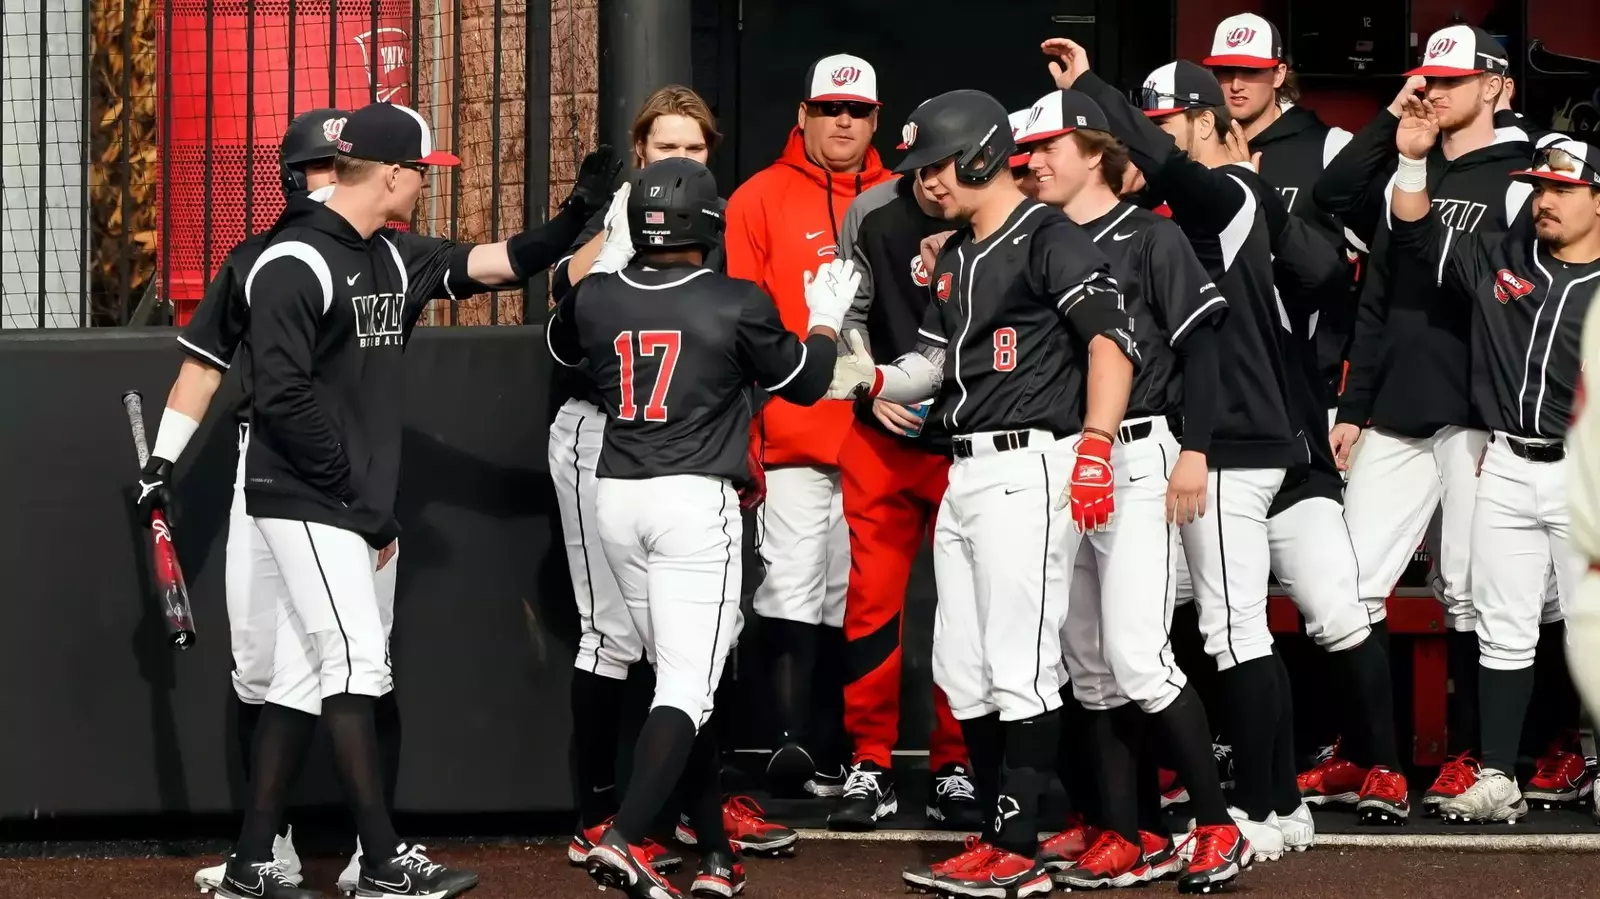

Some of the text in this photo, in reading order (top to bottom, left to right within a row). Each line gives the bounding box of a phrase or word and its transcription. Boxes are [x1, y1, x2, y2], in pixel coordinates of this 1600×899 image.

[649, 186, 661, 197] 17
[993, 327, 1018, 372] 8
[614, 330, 682, 422] 17
